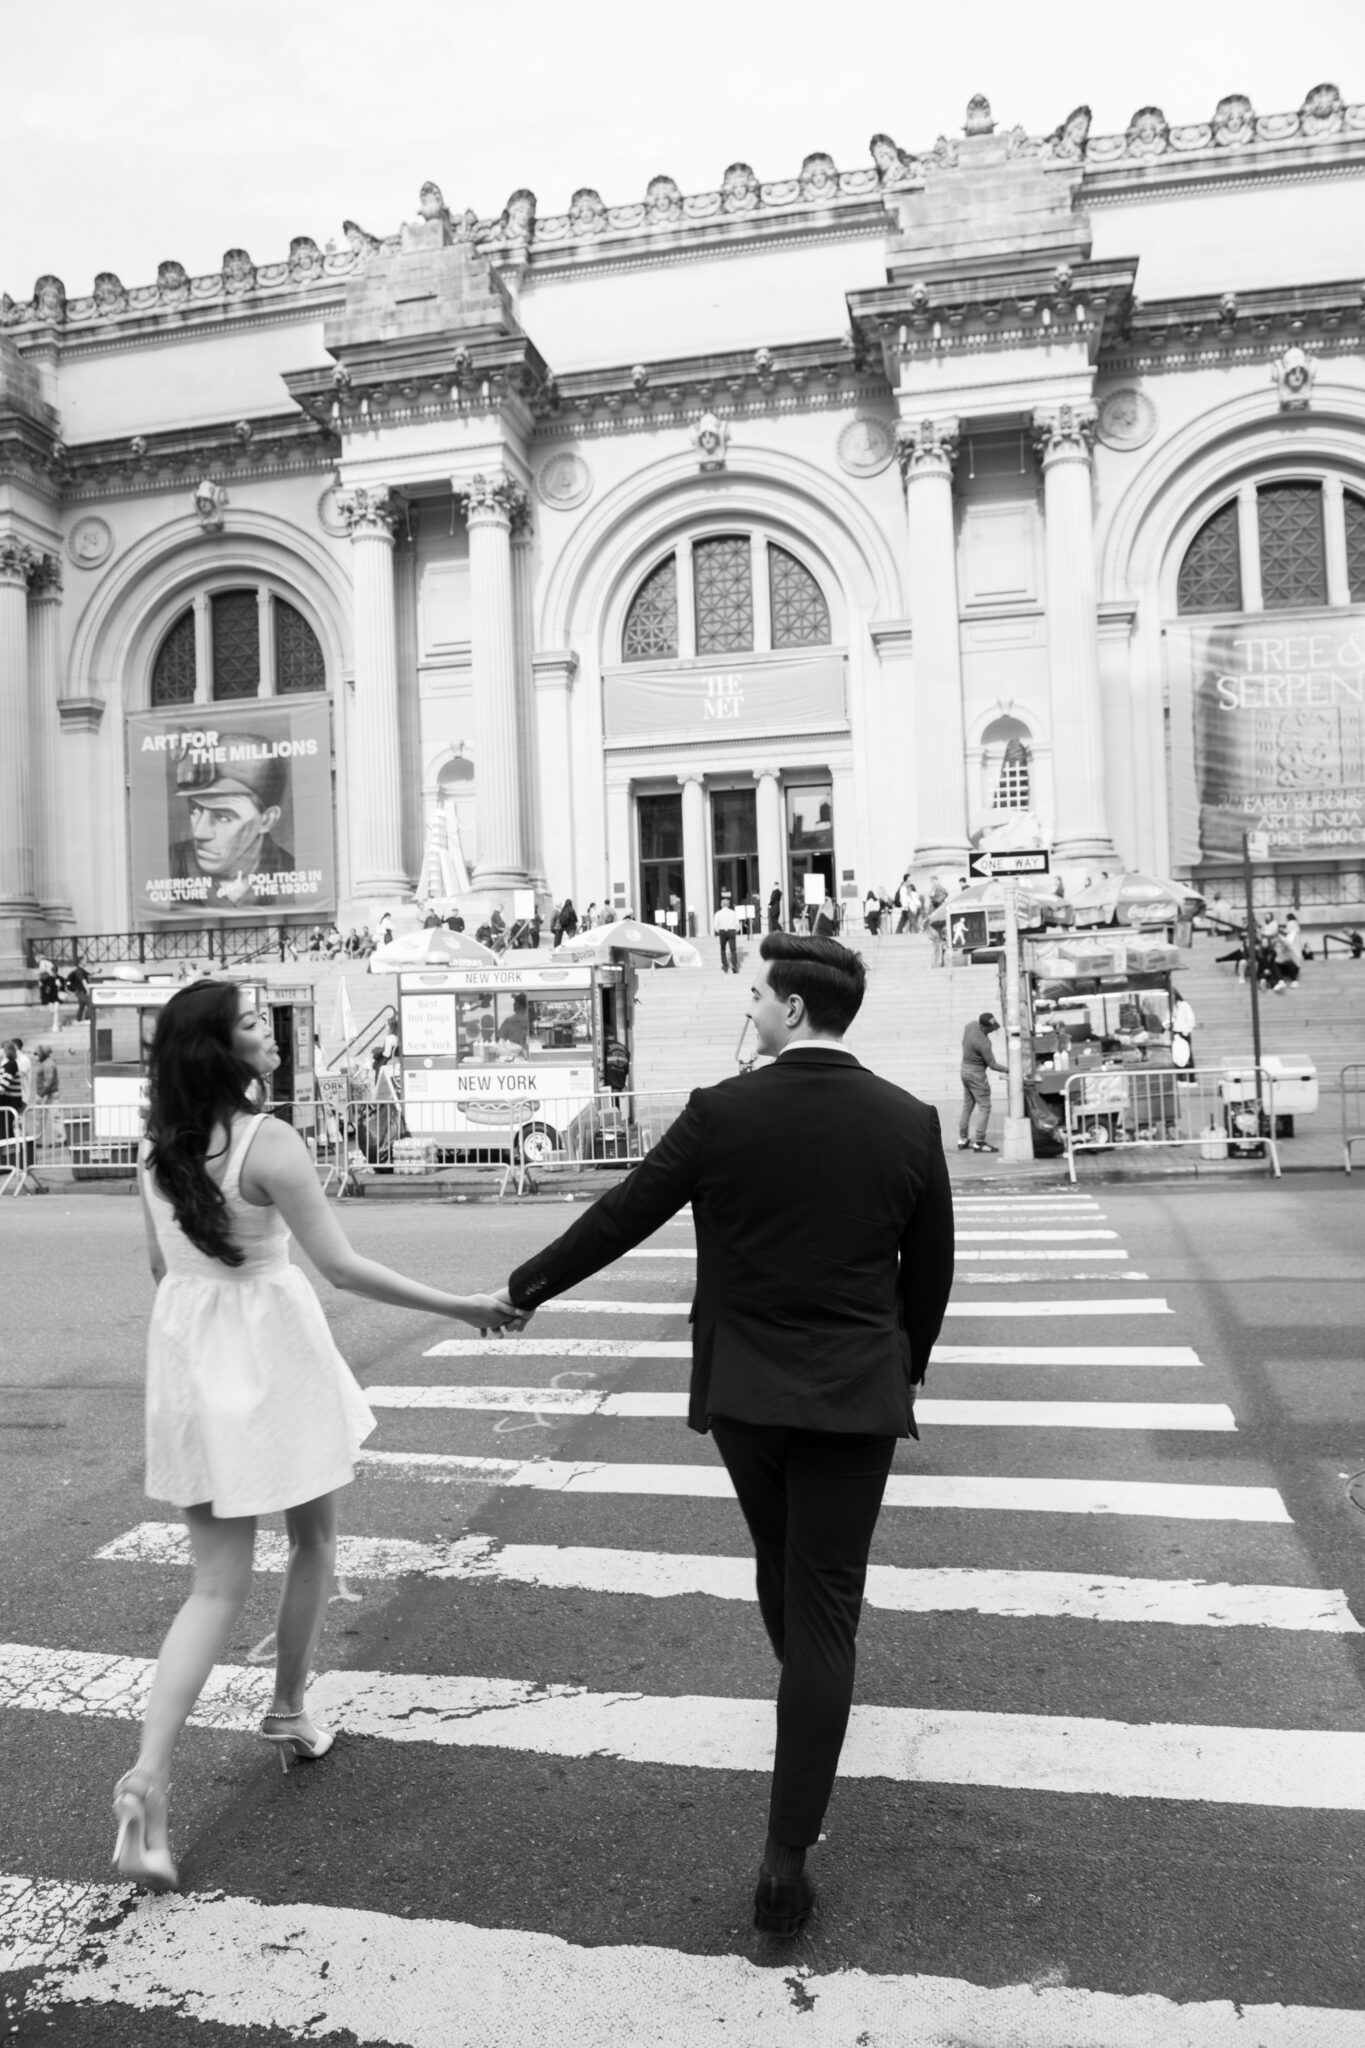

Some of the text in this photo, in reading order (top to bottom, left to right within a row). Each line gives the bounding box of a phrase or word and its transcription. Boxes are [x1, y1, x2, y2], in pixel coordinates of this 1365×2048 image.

[1234, 633, 1365, 671] TREE &
[702, 674, 743, 696] THE
[1217, 671, 1365, 710] SERPEN
[703, 696, 744, 719] MET
[142, 731, 219, 751] ART FOR
[189, 740, 317, 764] THE MILLIONS
[1243, 796, 1291, 813] EARLY
[1257, 811, 1363, 829] ART IN INDIA
[980, 858, 1039, 870] ONE WAY
[146, 878, 212, 891] AMERICAN
[216, 870, 243, 898] and
[248, 870, 322, 886] POLITICS IN
[150, 888, 207, 902] CULTURE
[252, 884, 278, 897] THE
[465, 972, 522, 984] NEW YORK
[274, 989, 297, 999] WATER
[407, 1040, 452, 1050] New York
[458, 1074, 537, 1091] NEW YORK
